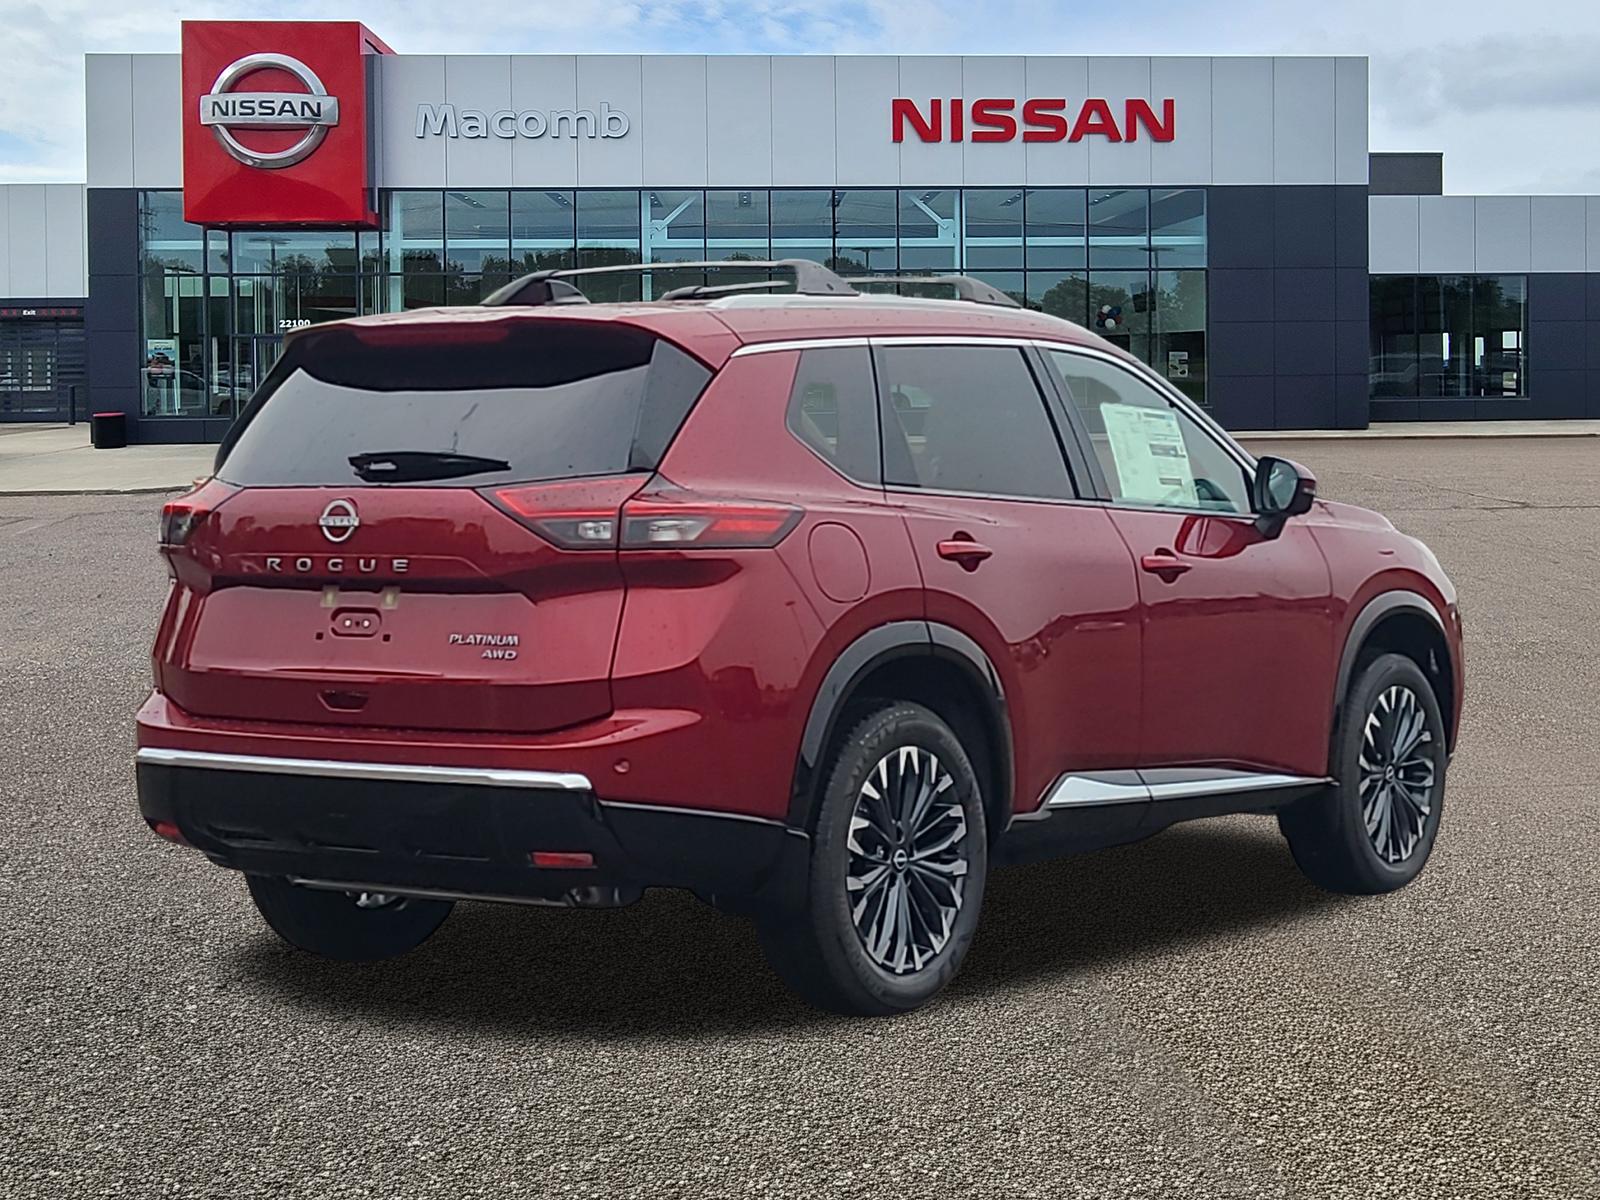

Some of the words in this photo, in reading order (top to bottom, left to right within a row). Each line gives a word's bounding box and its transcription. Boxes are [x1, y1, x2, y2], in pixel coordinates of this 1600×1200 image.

[211, 100, 323, 118] NISSAN
[415, 102, 630, 139] Macomb
[892, 98, 1175, 142] NISSAN
[279, 319, 311, 328] 22100
[266, 557, 409, 572] ROGUE
[449, 633, 519, 646] PLATINUM
[481, 649, 517, 660] AWD
